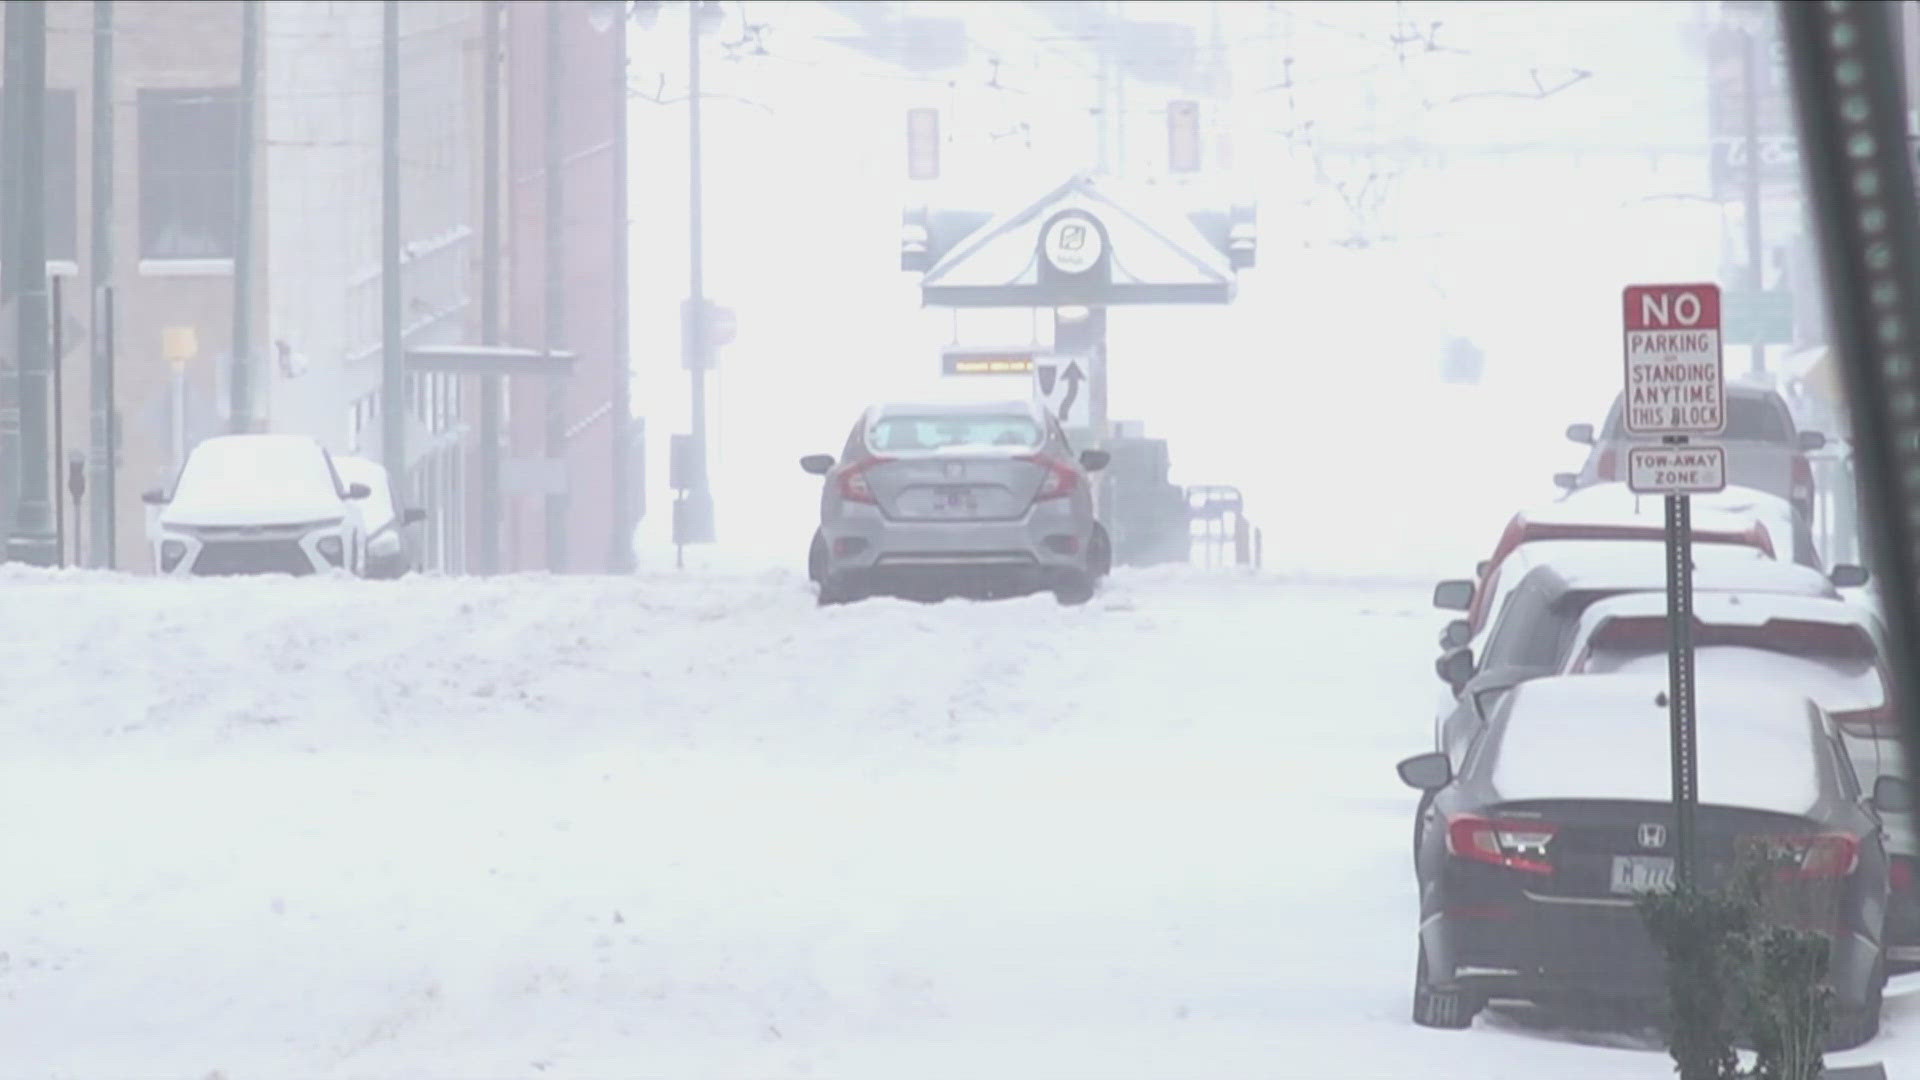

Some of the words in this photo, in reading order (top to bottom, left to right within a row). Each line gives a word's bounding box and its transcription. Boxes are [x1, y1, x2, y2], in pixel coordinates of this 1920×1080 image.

[1642, 292, 1701, 326] NO
[1632, 333, 1709, 353] PARKING
[1633, 363, 1715, 383] STANDING
[1633, 385, 1715, 404] ANYTIME
[1633, 406, 1664, 425] THIS
[1671, 405, 1718, 426] BLOCK
[1636, 454, 1717, 468] TOW-AWAY
[1656, 471, 1697, 484] ZONE
